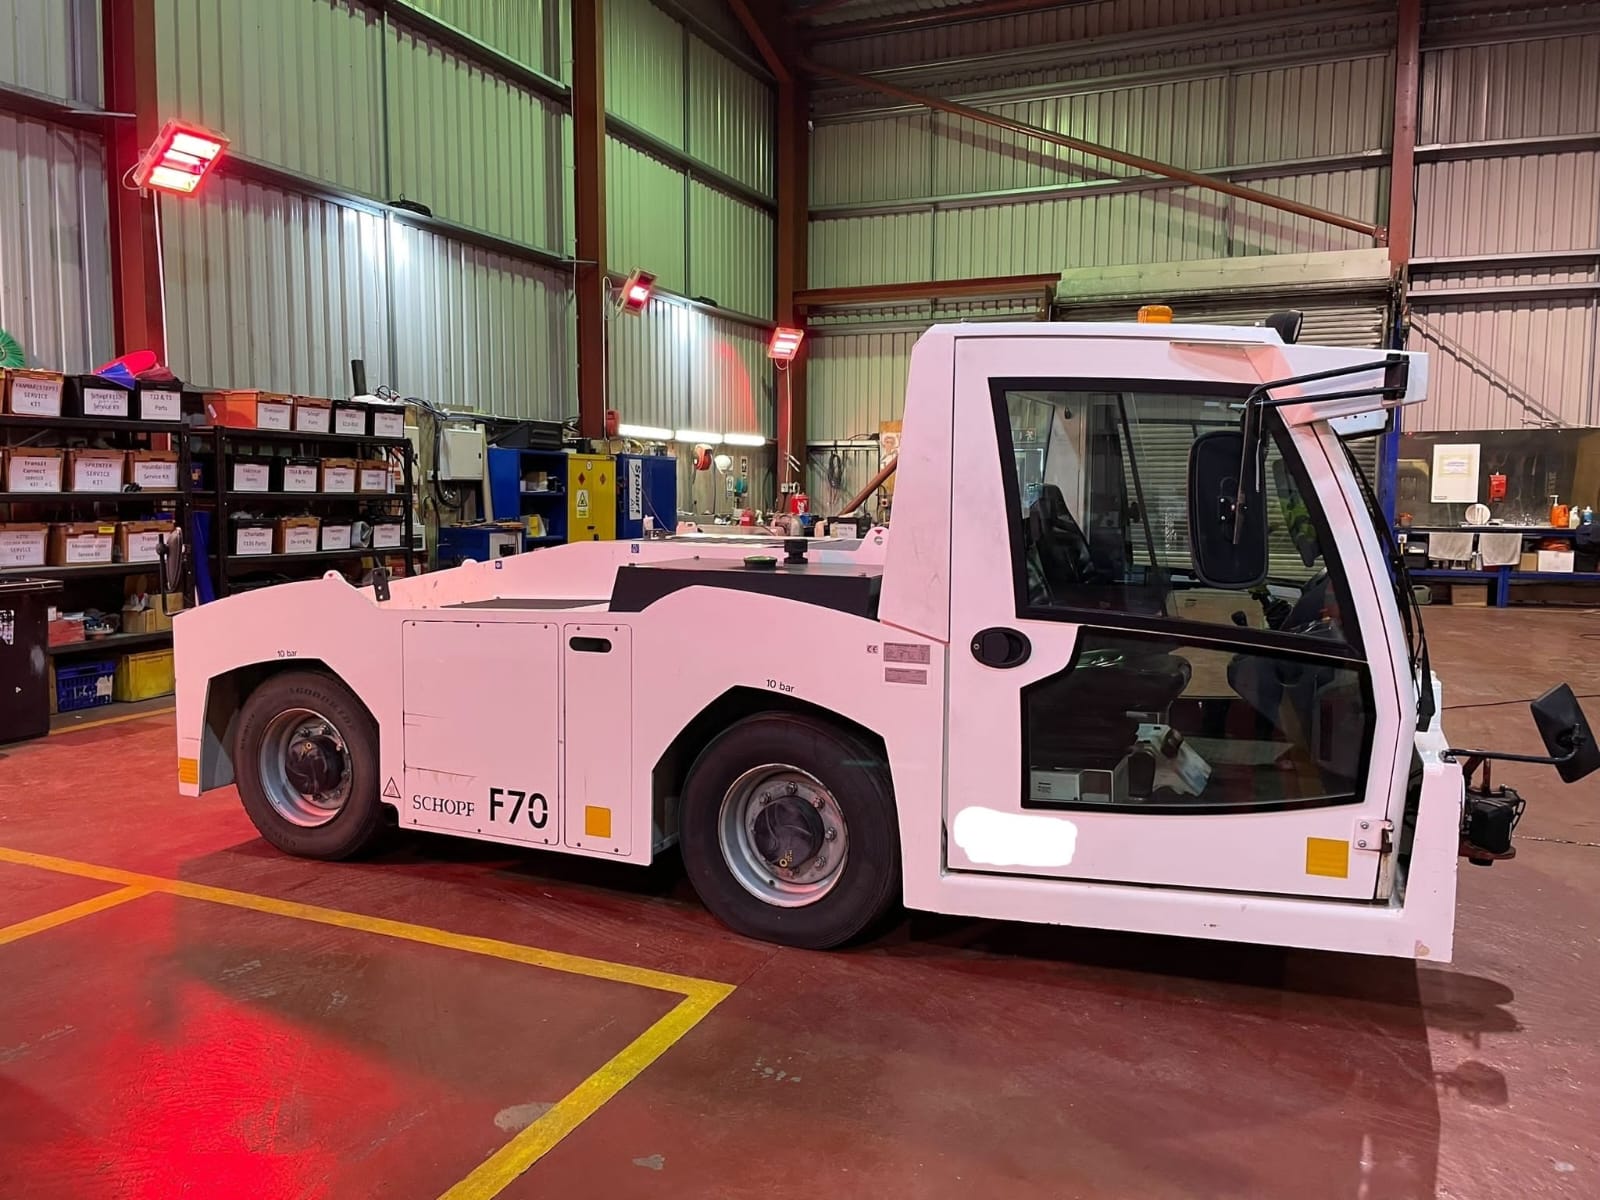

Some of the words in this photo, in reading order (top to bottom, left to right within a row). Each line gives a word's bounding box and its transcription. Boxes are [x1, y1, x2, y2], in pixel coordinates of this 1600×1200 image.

[634, 463, 642, 514] Stobart
[277, 649, 285, 657] 10
[286, 649, 297, 657] bar
[866, 645, 879, 654] CE
[766, 679, 777, 689] 10
[779, 681, 795, 693] bar
[412, 794, 475, 817] SCHOPF
[489, 787, 549, 829] F70
